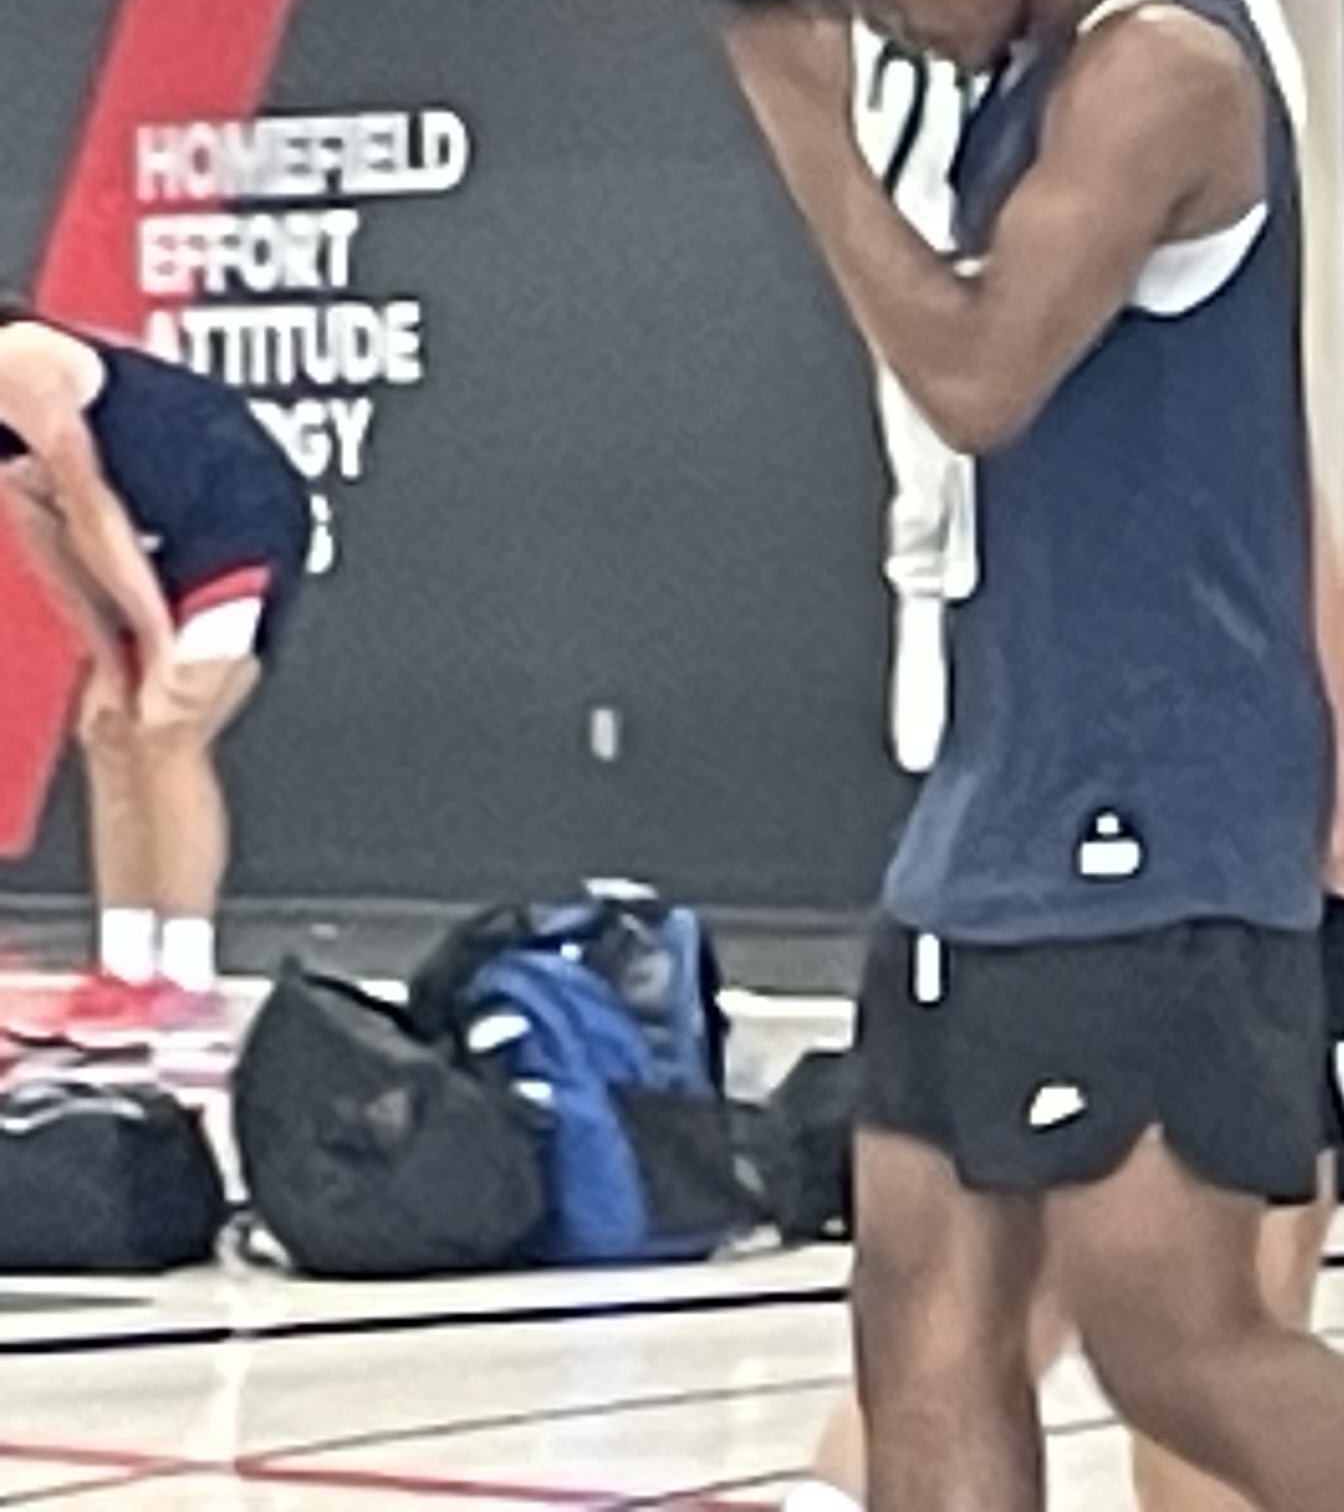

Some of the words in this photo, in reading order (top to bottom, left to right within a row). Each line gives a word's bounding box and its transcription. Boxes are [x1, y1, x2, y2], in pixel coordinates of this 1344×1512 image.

[136, 111, 468, 201] HOMEFIELD
[138, 209, 359, 293] EFFORT
[144, 300, 423, 385] ATTITUDE
